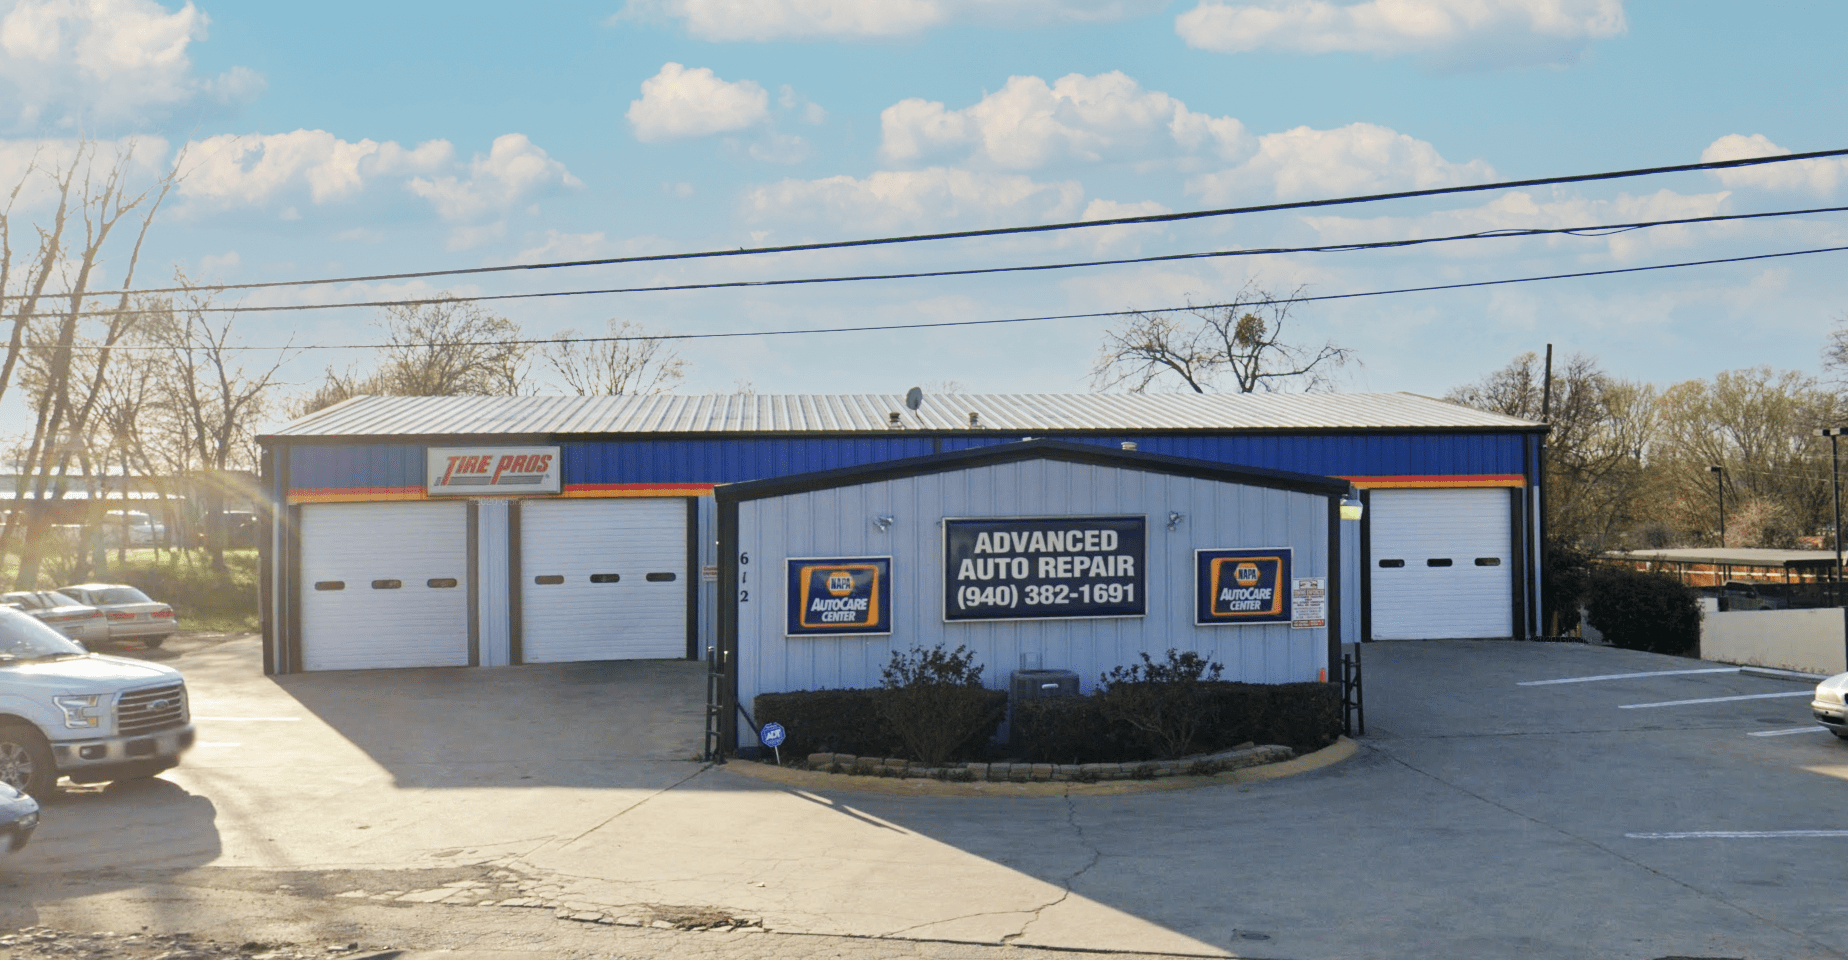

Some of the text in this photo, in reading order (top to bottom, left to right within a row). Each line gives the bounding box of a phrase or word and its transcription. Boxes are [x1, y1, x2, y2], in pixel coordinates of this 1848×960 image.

[441, 454, 553, 485] TIRE PROS
[974, 529, 1118, 554] ADVANCED
[957, 555, 1135, 580] AUTO REPAIR
[1238, 569, 1257, 580] NAPA
[830, 577, 852, 590] NAPA
[957, 582, 1135, 610] (940) 382-1691
[1230, 600, 1262, 611] CENTER
[821, 611, 856, 622] CENTER
[766, 730, 781, 741] ADT
